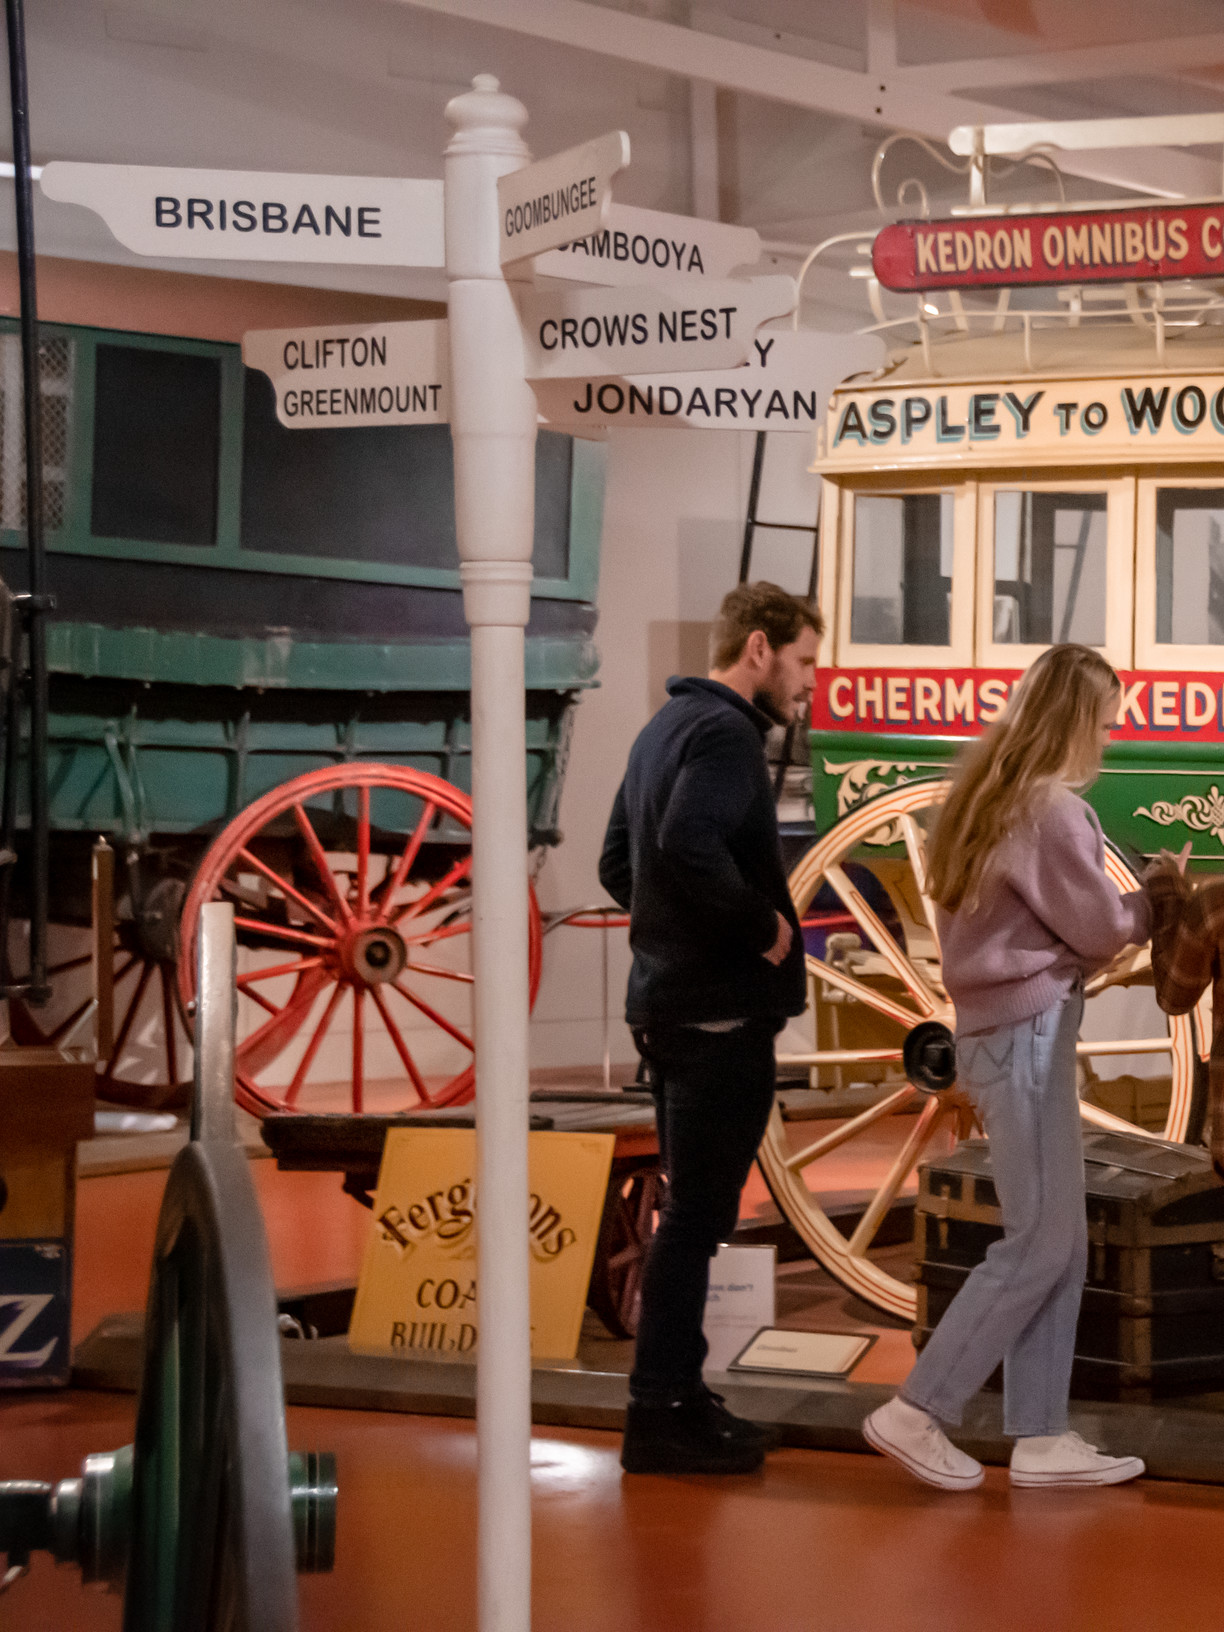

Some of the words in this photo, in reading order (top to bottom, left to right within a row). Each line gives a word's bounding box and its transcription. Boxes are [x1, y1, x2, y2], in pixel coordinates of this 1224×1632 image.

[155, 196, 382, 238] BRISBANE
[505, 176, 597, 237] GOOMBUNGEE
[557, 228, 705, 275] AMBOOYA
[916, 228, 1033, 273] KEDRON
[1042, 218, 1189, 267] OMNIBUS
[539, 313, 649, 350] CROWS
[659, 307, 737, 343] NEST
[284, 335, 387, 370] CLIFTON
[284, 384, 443, 417] GREENMOUNT
[573, 383, 817, 420] JONDARYAN
[834, 391, 1046, 446] ASPLEY
[1055, 402, 1108, 436] TO
[828, 676, 1019, 727] CHERMS
